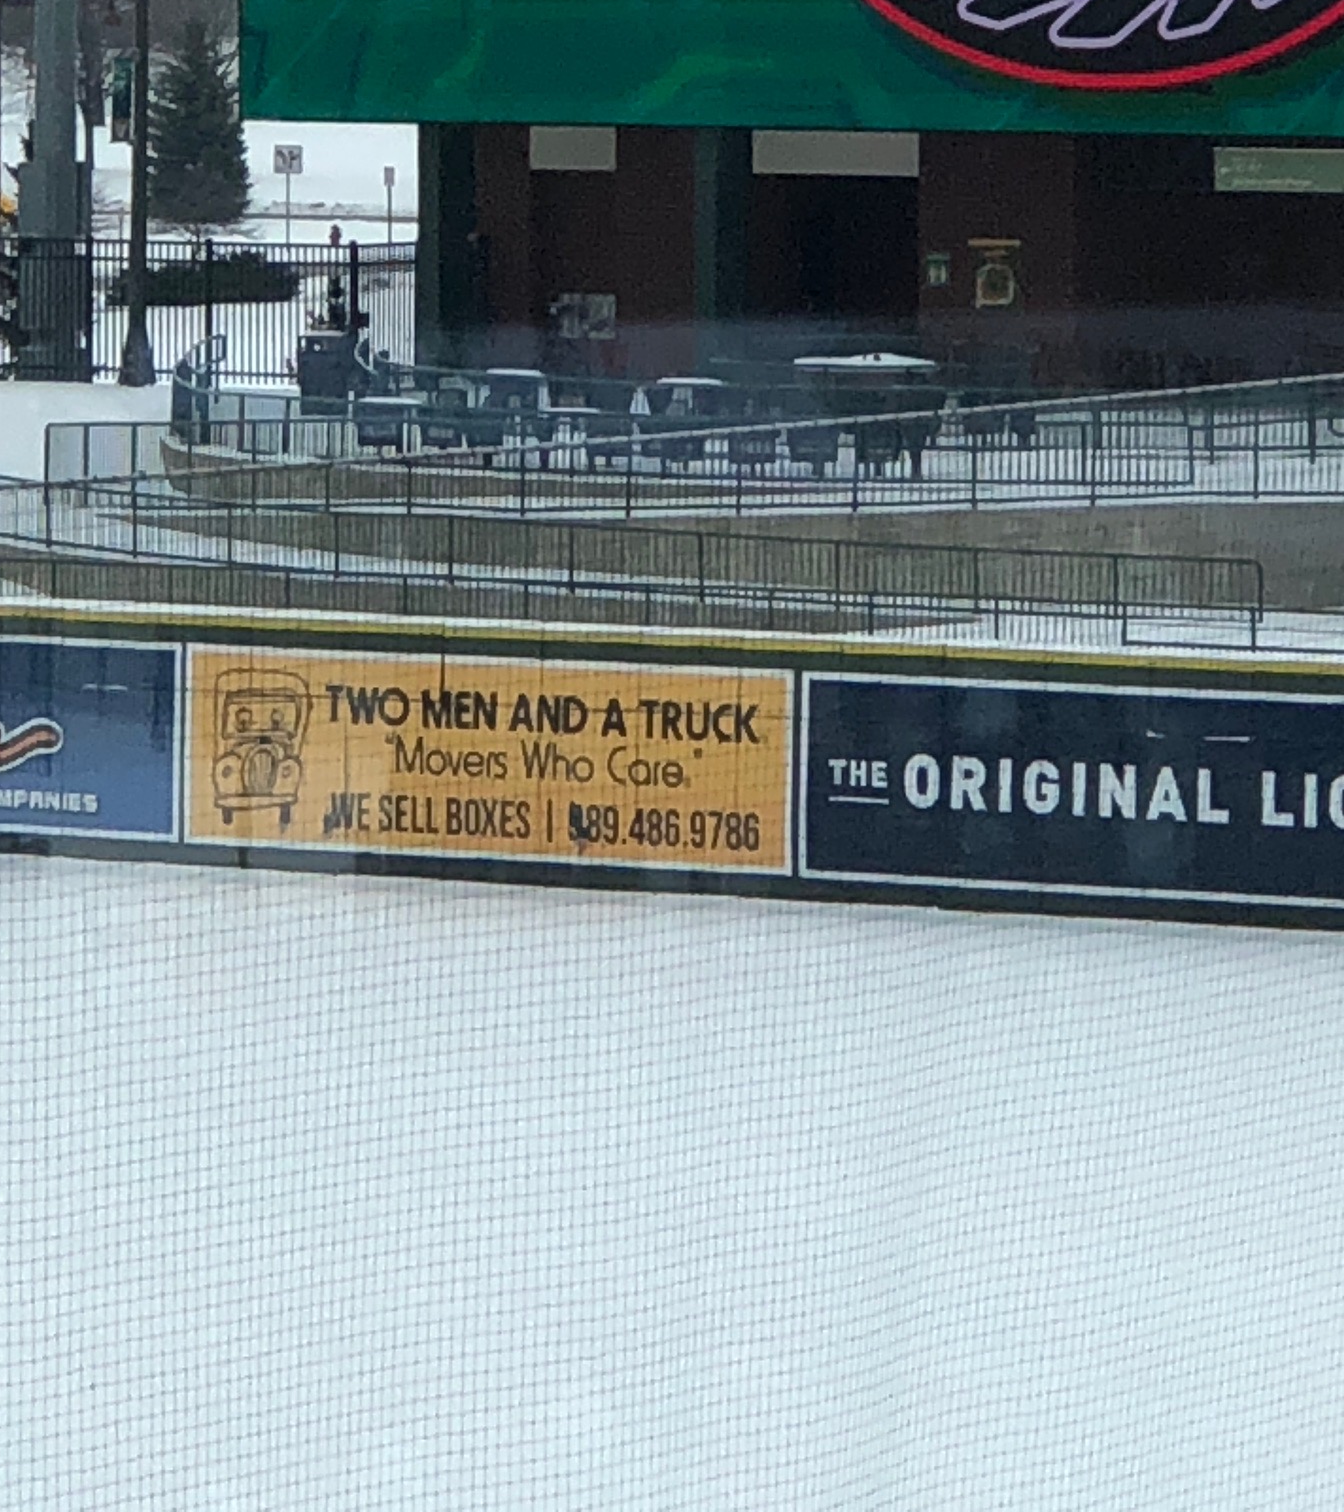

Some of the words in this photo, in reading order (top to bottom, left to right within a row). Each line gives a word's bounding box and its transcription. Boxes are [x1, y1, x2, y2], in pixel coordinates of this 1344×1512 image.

[325, 684, 411, 727] TWO
[421, 688, 498, 731] MEN
[508, 692, 589, 735] AND
[601, 697, 628, 738] A
[638, 698, 761, 745] TRUCK
[520, 739, 595, 784] Who
[330, 791, 372, 833] WE
[378, 794, 440, 834] SELL
[446, 796, 531, 840] BOXES
[827, 756, 890, 790] THE
[903, 753, 1230, 826] ORIGINAL
